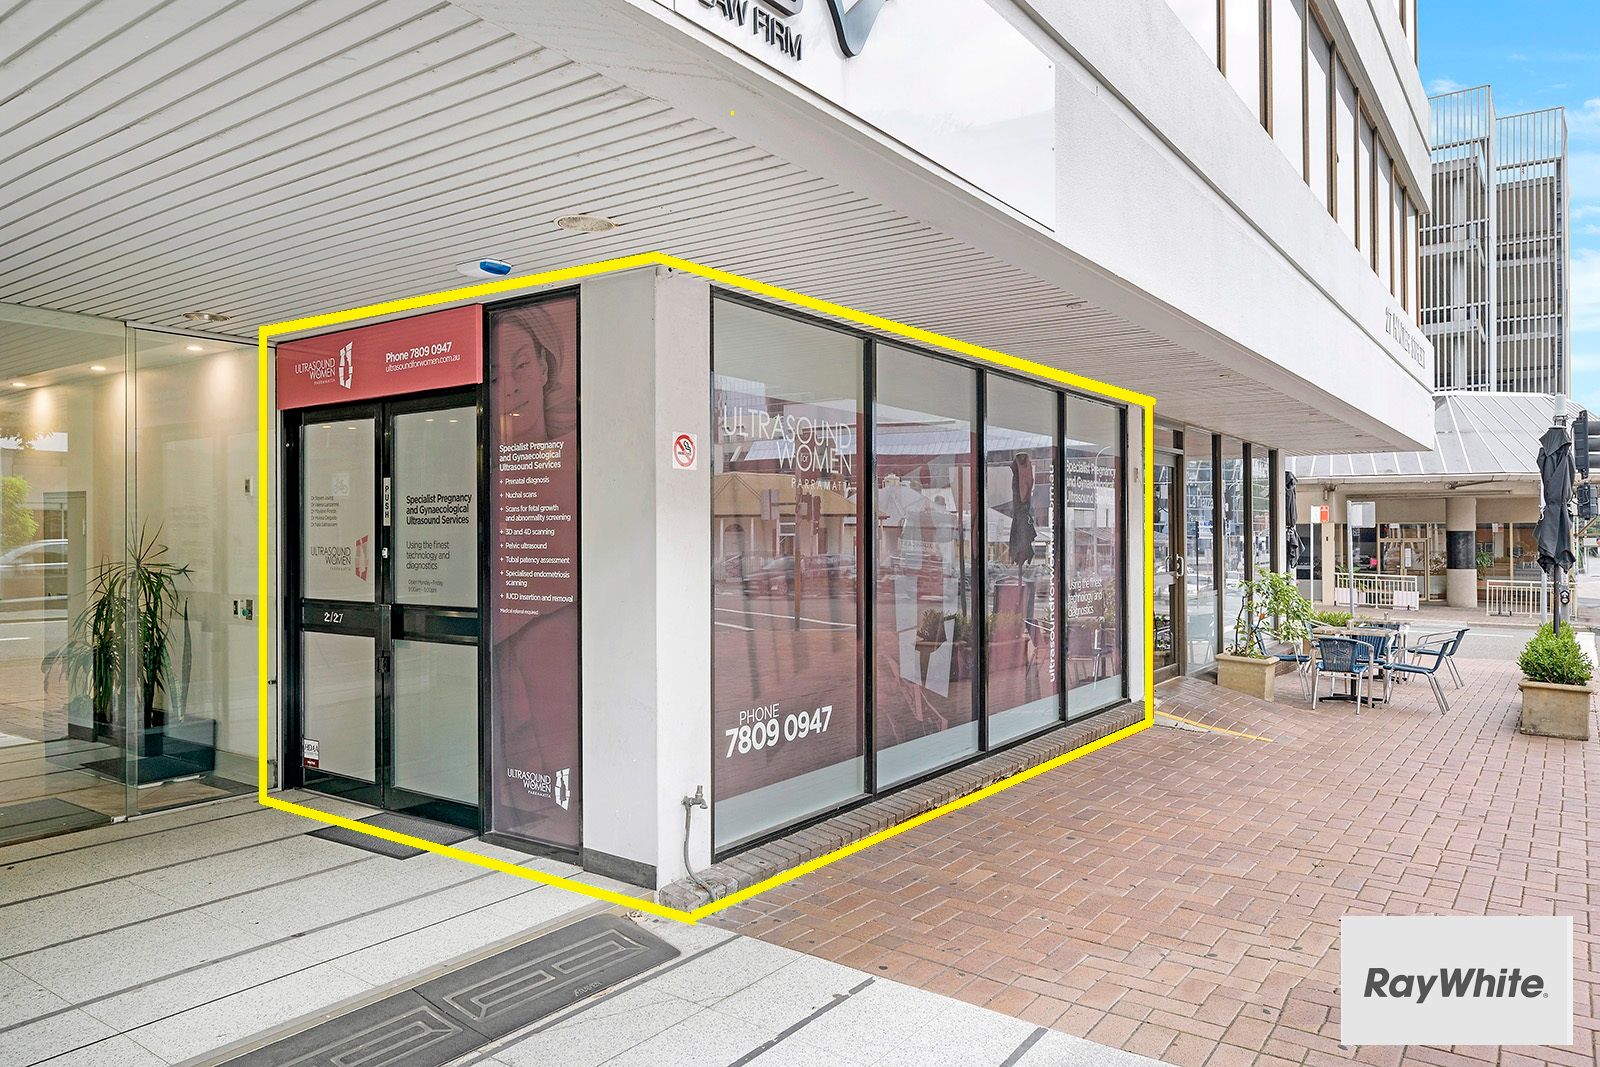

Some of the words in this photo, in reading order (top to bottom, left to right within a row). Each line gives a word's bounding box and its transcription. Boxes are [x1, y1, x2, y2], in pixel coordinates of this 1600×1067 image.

[753, 6, 802, 61] FIRM
[385, 350, 409, 363] Phone
[410, 346, 430, 359] 7809
[431, 341, 453, 355] 0947
[294, 357, 336, 374] ULTRASOUND
[385, 354, 461, 373] ultrasoundforwomen.com.au
[310, 367, 336, 379] WOMEN
[724, 404, 852, 450] ULTRASOUND
[499, 443, 529, 454] Specialist
[530, 441, 564, 450] Pregnancy
[499, 454, 512, 462] and
[512, 450, 561, 462] Gynaecological
[777, 441, 852, 475] WOMEN
[499, 462, 533, 471] Ultrasound
[534, 461, 562, 469] Services
[505, 477, 525, 485] Prenatal
[526, 476, 550, 485] diagnosis
[406, 494, 436, 505] Specialist
[437, 493, 473, 504] Pregnancy
[406, 505, 418, 514] and
[419, 504, 469, 516] Gynaecological
[540, 504, 559, 513] growth
[406, 515, 440, 526] Ultrasound
[441, 515, 470, 525] Services
[516, 514, 545, 522] abnormality
[546, 514, 571, 522] screening
[532, 528, 555, 536] scanning
[406, 541, 422, 550] Using
[422, 541, 432, 549] the
[433, 540, 450, 549] finest
[311, 546, 352, 557] ULTRASOUND
[406, 551, 437, 561] technology
[438, 551, 450, 560] and
[325, 556, 351, 565] WOMEN
[406, 562, 438, 571] diagnostics
[505, 570, 533, 578] Specialised
[505, 579, 528, 587] scanning
[519, 593, 540, 601] insertion
[552, 595, 573, 603] removal
[324, 611, 344, 624] 2/27
[739, 703, 779, 725] PHONE
[725, 718, 780, 758] 7809
[783, 705, 833, 742] 0947
[507, 768, 551, 785] ULTRASOUND
[523, 779, 551, 793] WOMEN
